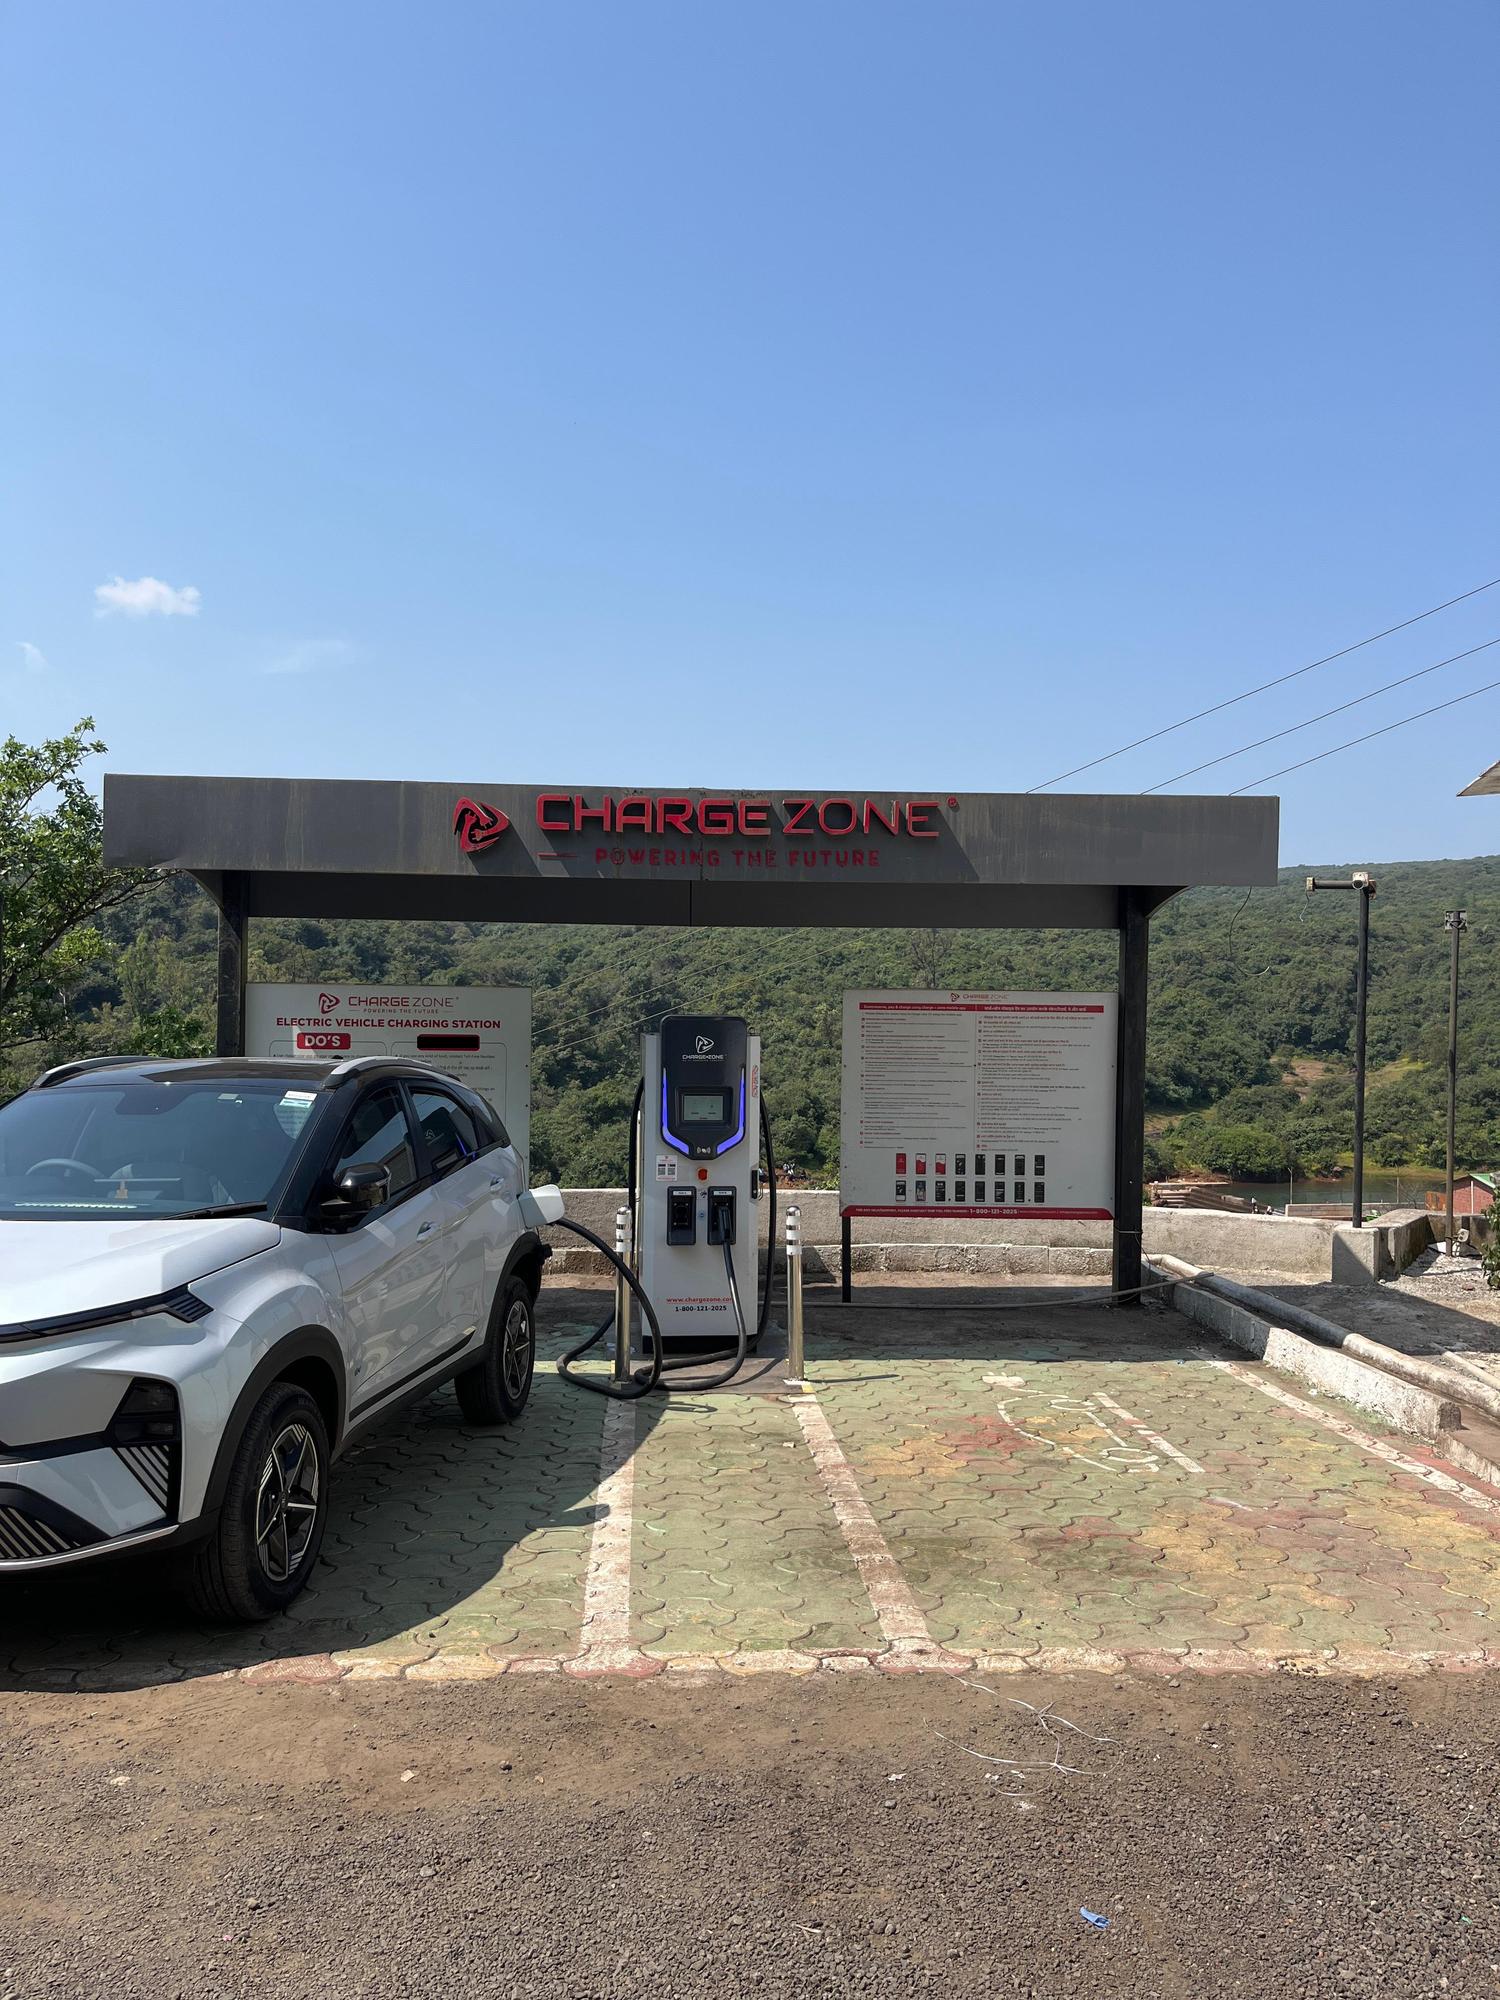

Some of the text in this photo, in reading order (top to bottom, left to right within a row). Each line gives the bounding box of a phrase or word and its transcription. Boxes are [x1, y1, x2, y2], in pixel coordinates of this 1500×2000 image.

[536, 793, 771, 835] CHARGE
[595, 847, 880, 867] POWERING THE FUTURE
[348, 996, 410, 1007] CHARGE
[277, 1018, 501, 1028] ELECTRIC VEHICLE CHARGING STATION
[305, 1035, 341, 1046] DO'S
